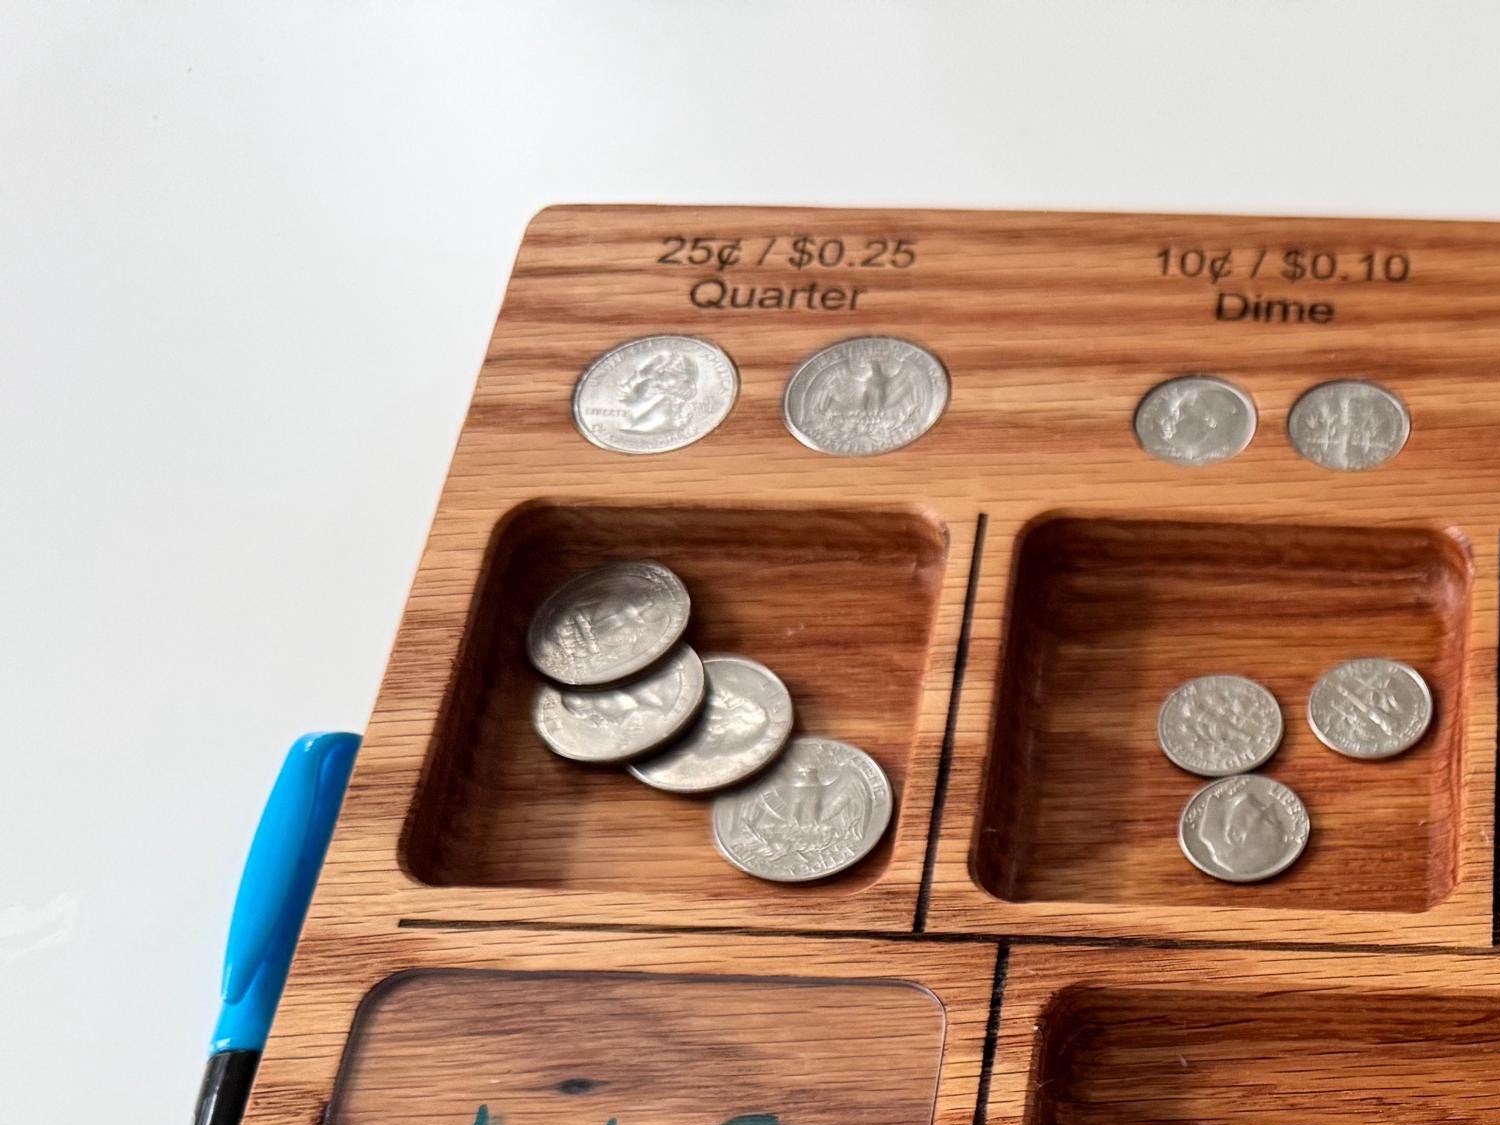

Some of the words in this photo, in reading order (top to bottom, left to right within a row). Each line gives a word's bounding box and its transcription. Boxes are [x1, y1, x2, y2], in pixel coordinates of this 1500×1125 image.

[656, 234, 743, 271] 25¢
[757, 237, 777, 267] /
[787, 236, 919, 271] $0.25
[1156, 247, 1233, 284] 10¢
[1250, 249, 1267, 280] /
[1280, 247, 1411, 284] $0.10
[689, 276, 868, 312] Quarter
[1214, 291, 1336, 325] Dime
